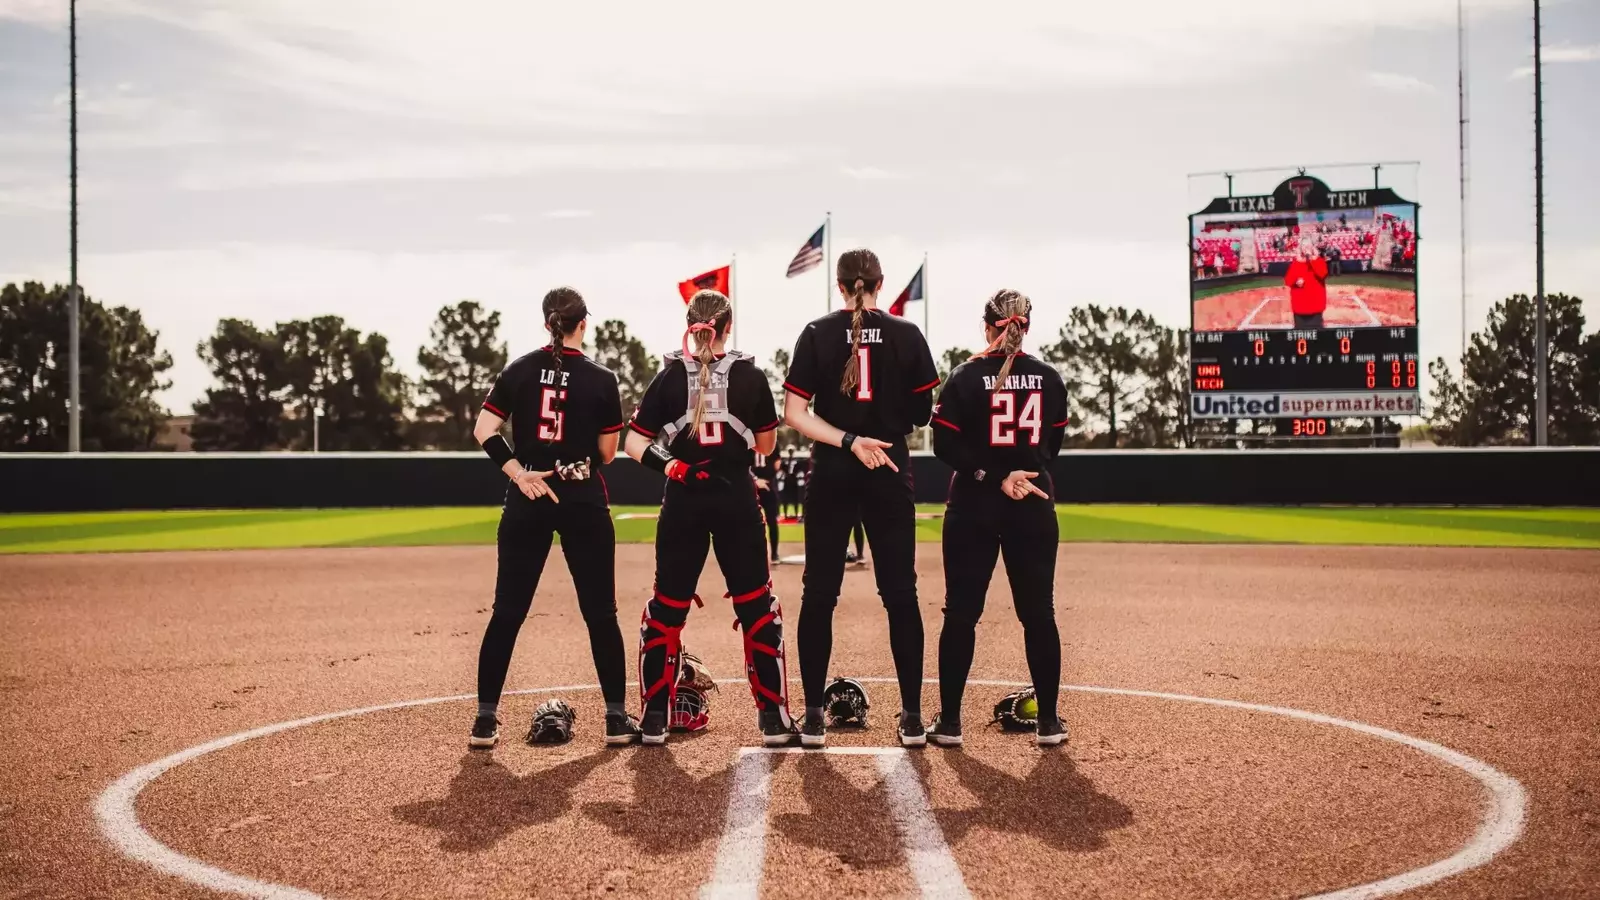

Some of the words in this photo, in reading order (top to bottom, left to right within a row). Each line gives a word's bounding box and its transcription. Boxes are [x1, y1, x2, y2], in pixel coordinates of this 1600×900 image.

[1228, 196, 1275, 211] TEXAS
[1327, 192, 1367, 206] TECH
[846, 328, 883, 344] KEHL
[1195, 333, 1205, 343] AT
[1208, 333, 1223, 343] BAT
[1248, 332, 1270, 342] BALL
[1287, 331, 1318, 341] STRIKE
[1336, 330, 1354, 339] OUT
[1390, 329, 1406, 338] H/E
[1254, 339, 1264, 356] 0
[1297, 338, 1307, 355] 0
[1341, 337, 1350, 354] 0
[1233, 357, 1237, 365] 1
[1244, 357, 1248, 365] 2
[1269, 356, 1273, 364] 4
[1280, 356, 1285, 364] 5
[1291, 356, 1296, 364] 6
[1306, 356, 1310, 364] 7
[1316, 355, 1321, 364] 8
[1328, 355, 1332, 363] 9
[1341, 355, 1349, 363] 10
[1356, 354, 1376, 362] RUNS
[1367, 360, 1375, 374] 0
[1392, 360, 1400, 374] 0
[1408, 360, 1415, 374] 0
[540, 369, 570, 386] LOE
[856, 345, 873, 402] 1
[982, 375, 1043, 390] BANHART
[1195, 379, 1224, 389] TECH
[1367, 375, 1375, 388] 0
[1392, 375, 1400, 387] 0
[1408, 375, 1416, 387] 0
[1193, 394, 1280, 414] United
[1282, 395, 1413, 416] supermarkets
[538, 386, 568, 442] 5
[990, 391, 1042, 446] 24
[1293, 419, 1326, 436] 3:00
